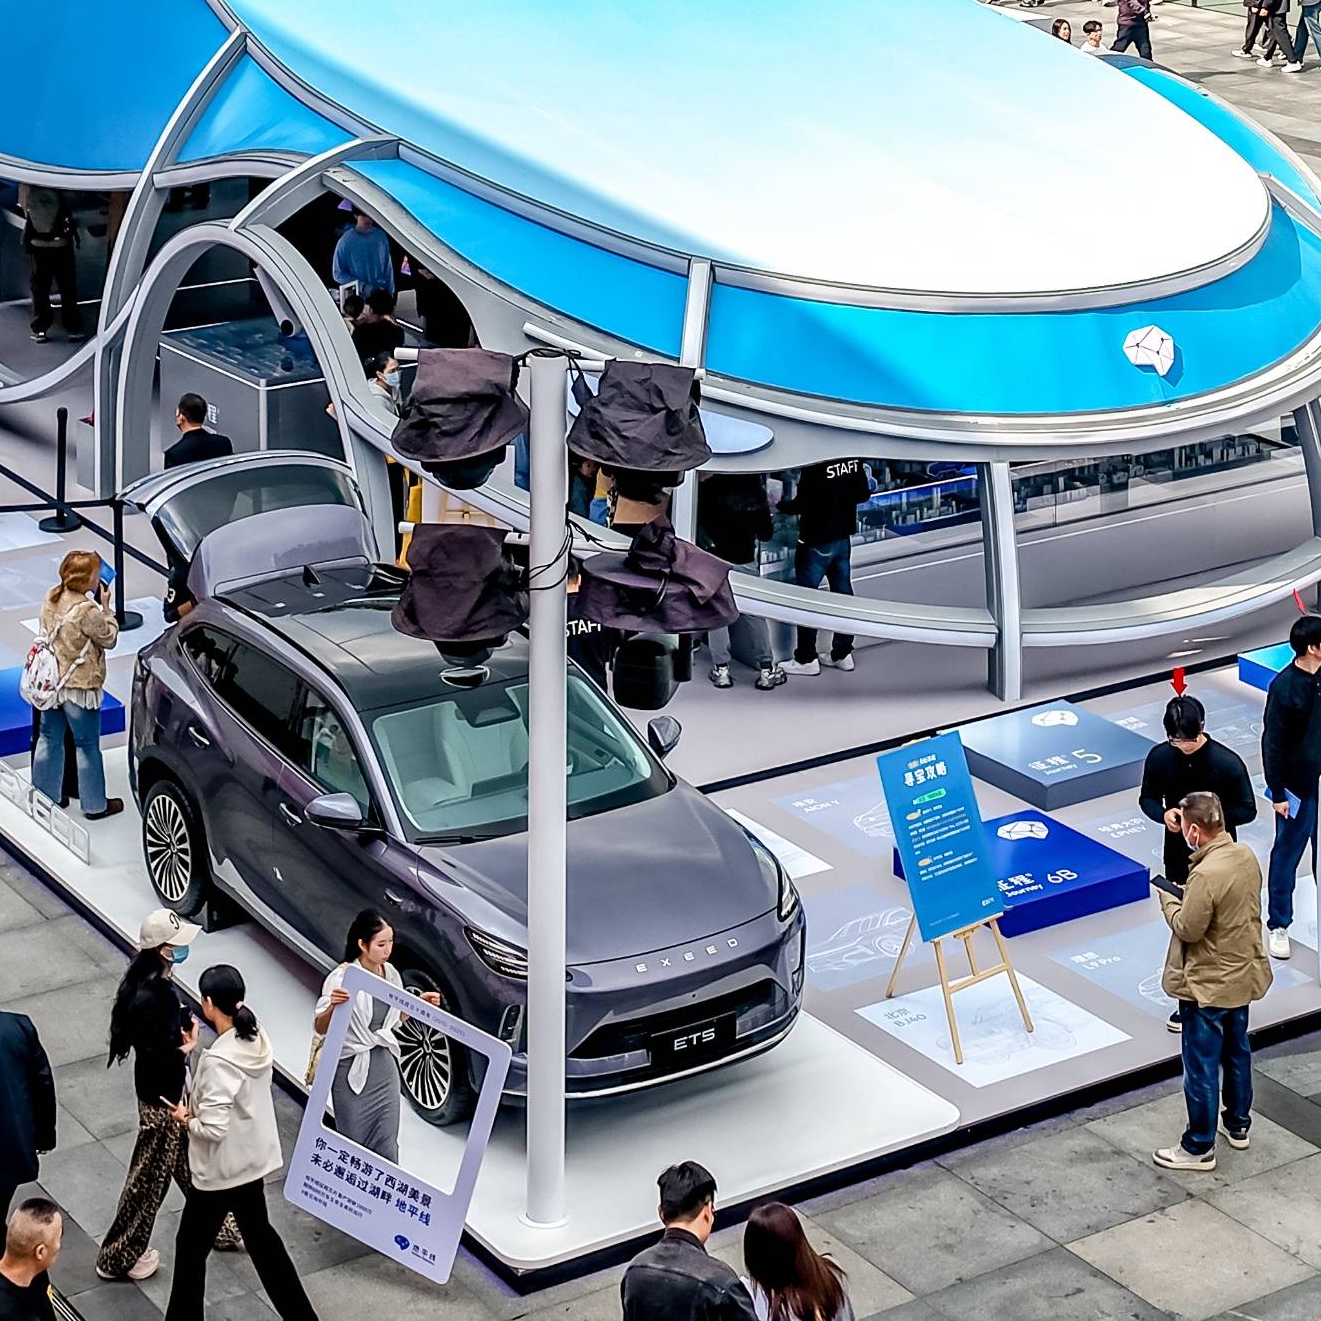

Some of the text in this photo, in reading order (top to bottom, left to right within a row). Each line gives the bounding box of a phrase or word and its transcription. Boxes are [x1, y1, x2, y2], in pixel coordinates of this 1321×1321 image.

[1072, 749, 1103, 765] 5
[903, 761, 947, 787] 寻宝攻略
[1047, 869, 1078, 884] 6B
[635, 938, 738, 973] EXEED
[315, 1136, 432, 1209] 你一定畅游了西湖美景
[310, 1152, 392, 1205] 未必邂逅过湖畔
[395, 1197, 432, 1228] 地平线
